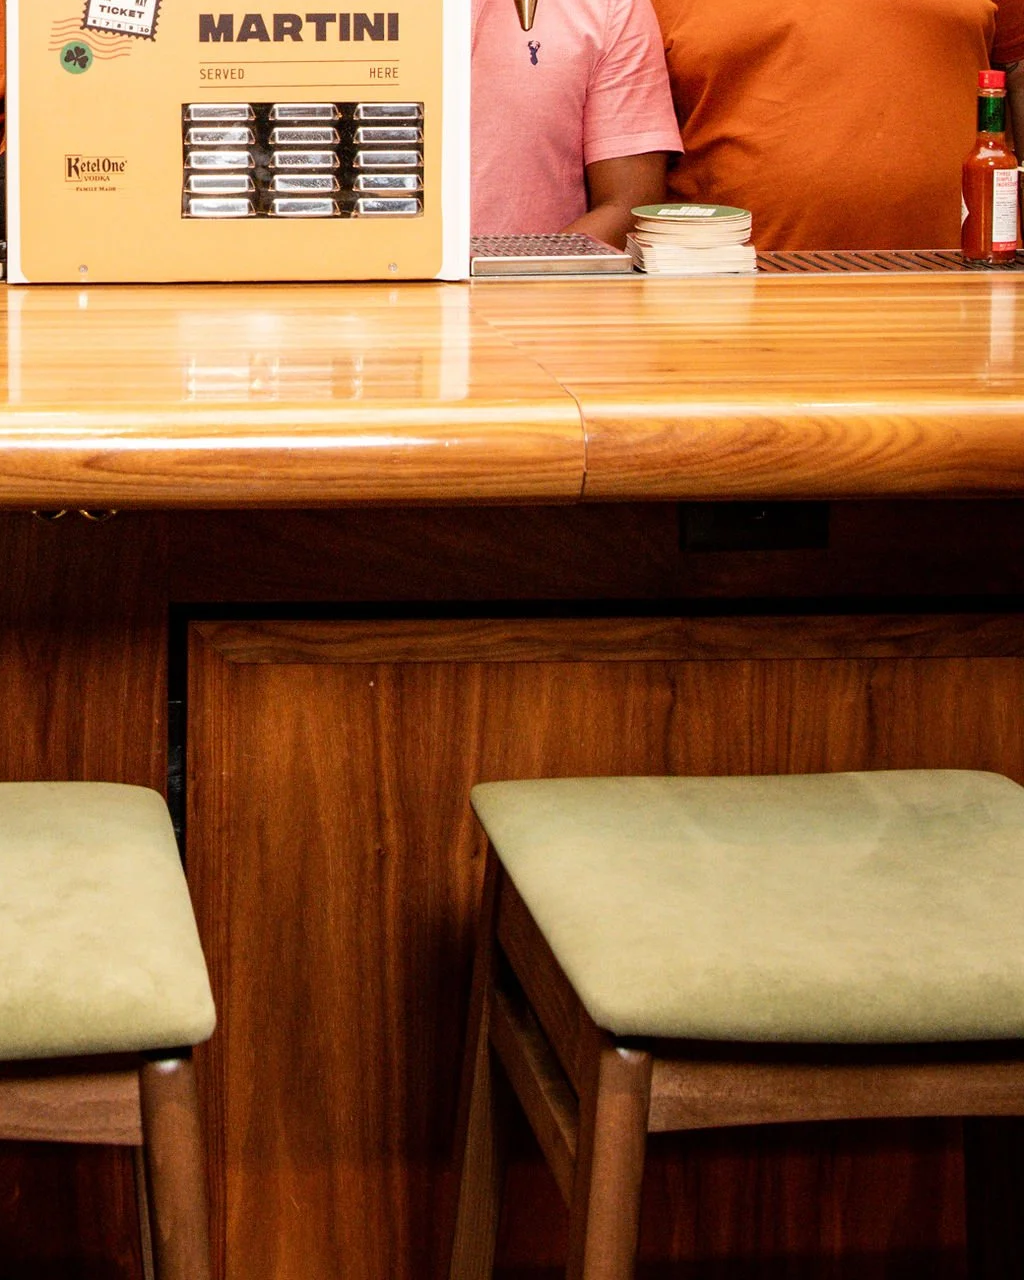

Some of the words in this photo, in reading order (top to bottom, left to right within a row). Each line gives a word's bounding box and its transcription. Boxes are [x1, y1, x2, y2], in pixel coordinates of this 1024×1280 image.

[99, 4, 145, 19] TICKET
[199, 13, 399, 42] MARTINI
[200, 68, 245, 80] SERVED
[369, 67, 399, 79] HERE
[67, 157, 100, 179] Ketel
[102, 157, 125, 172] One
